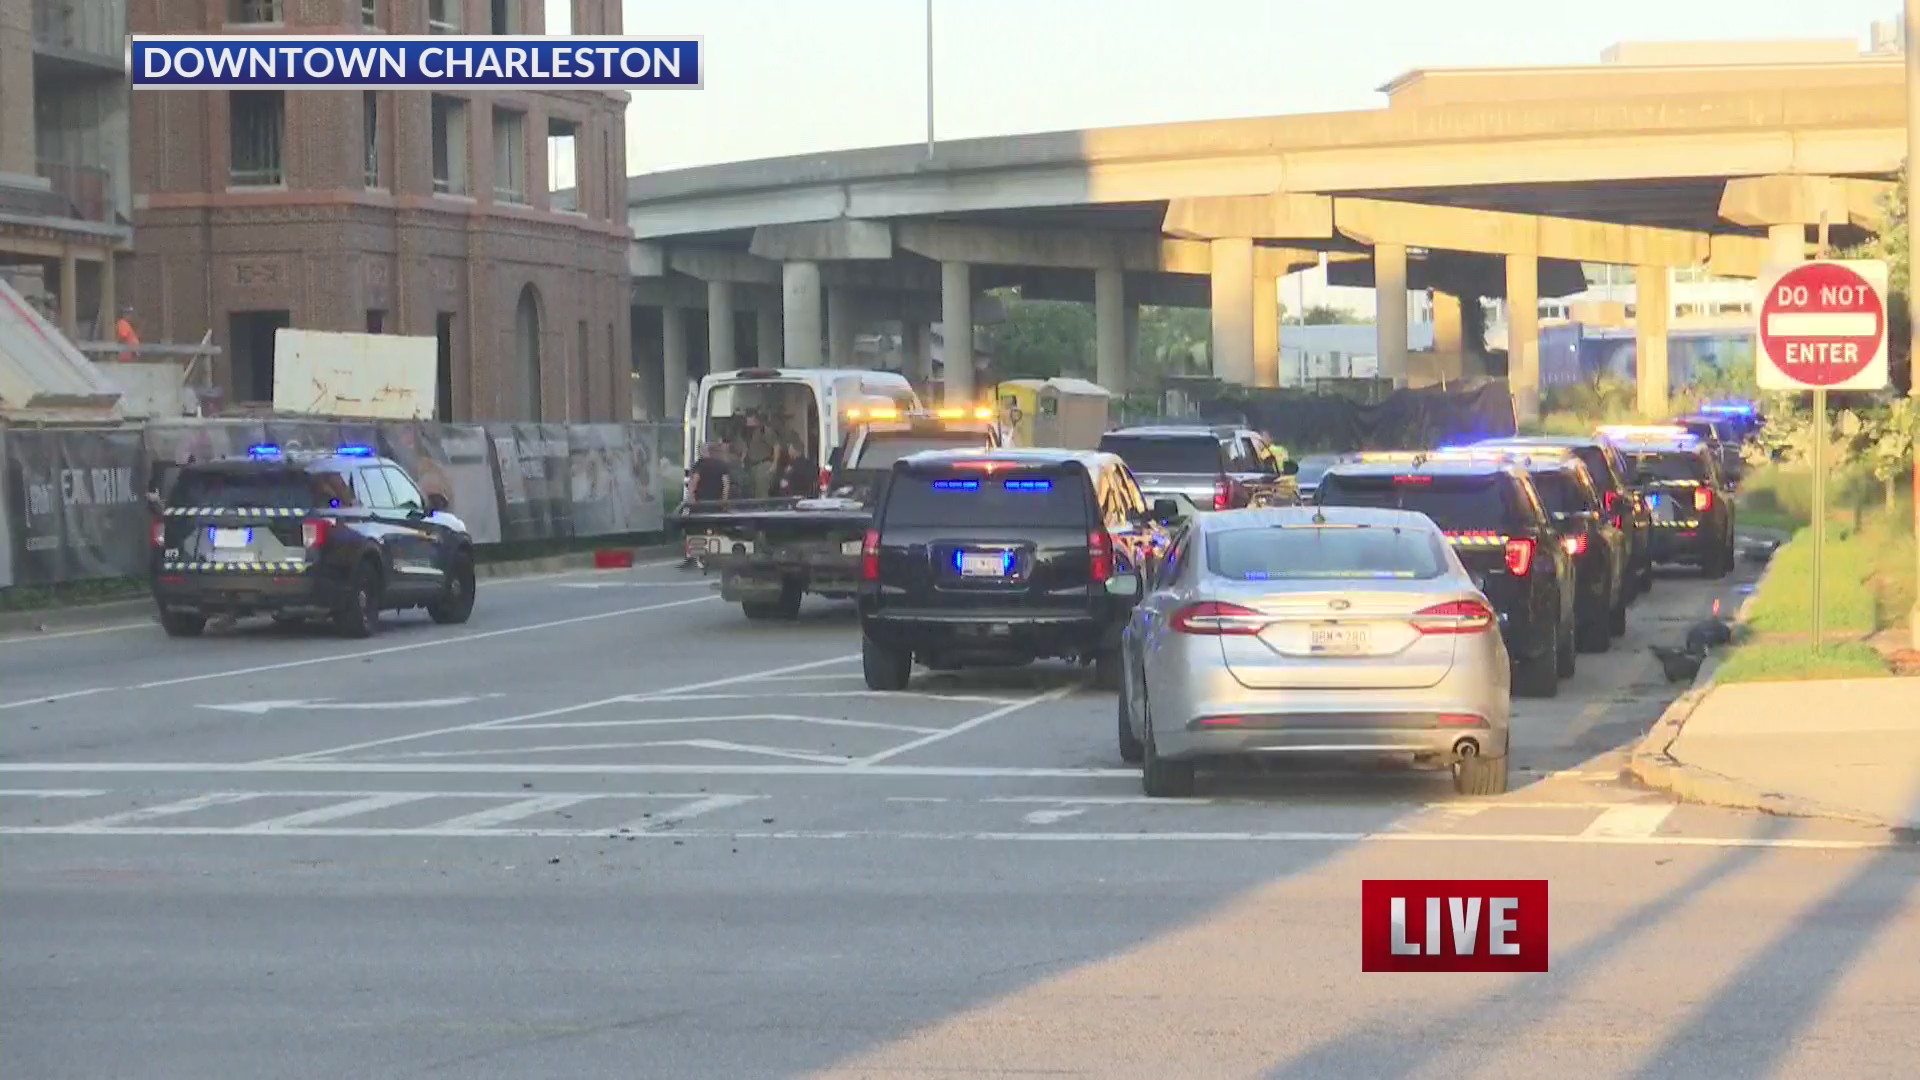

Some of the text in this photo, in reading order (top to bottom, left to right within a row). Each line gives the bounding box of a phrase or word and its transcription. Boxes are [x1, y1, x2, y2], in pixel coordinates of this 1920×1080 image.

[1777, 284, 1868, 307] DO NOT
[1786, 342, 1858, 364] ENTER
